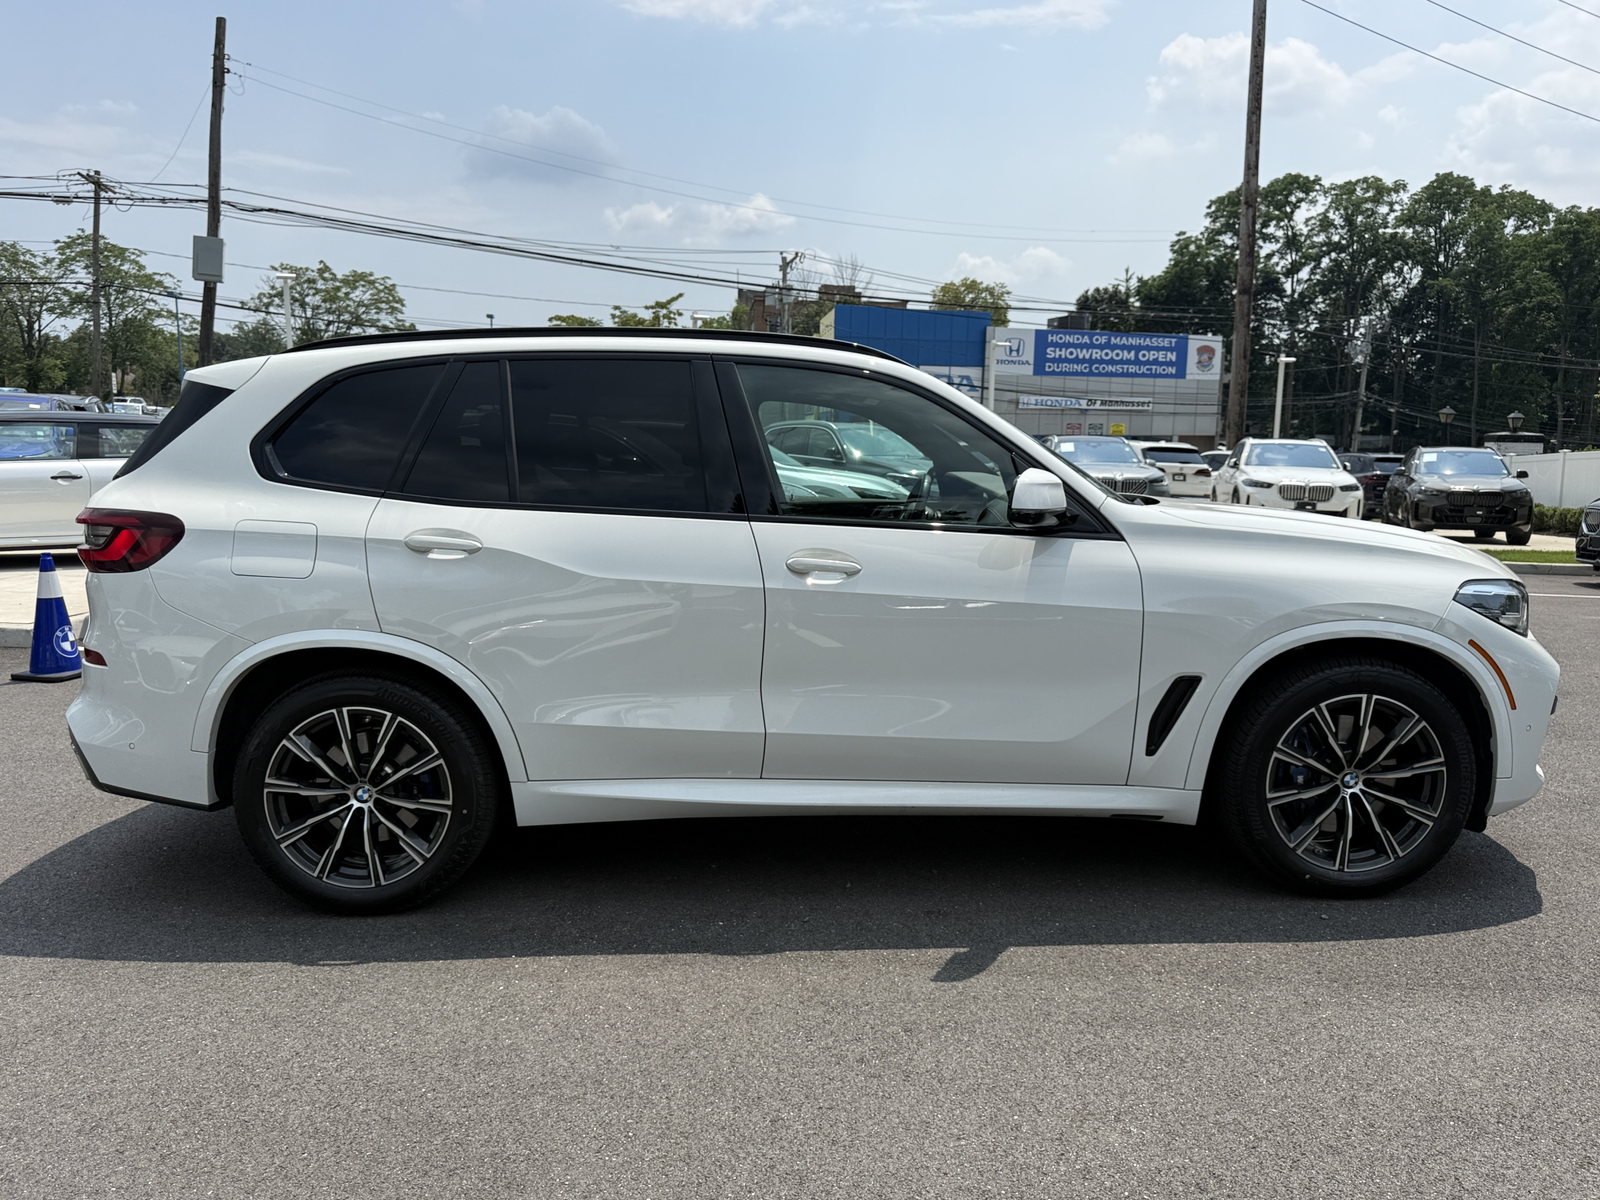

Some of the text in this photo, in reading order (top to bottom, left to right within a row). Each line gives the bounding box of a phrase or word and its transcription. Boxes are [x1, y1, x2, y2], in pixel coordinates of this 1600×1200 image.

[1047, 333, 1177, 347] HONDA OF MANHASSET
[1046, 347, 1177, 362] SHOWROOM OPEN
[995, 358, 1032, 366] HONDA
[1045, 362, 1177, 375] DURING CONSTRUCTION
[1034, 398, 1082, 407] HONDA
